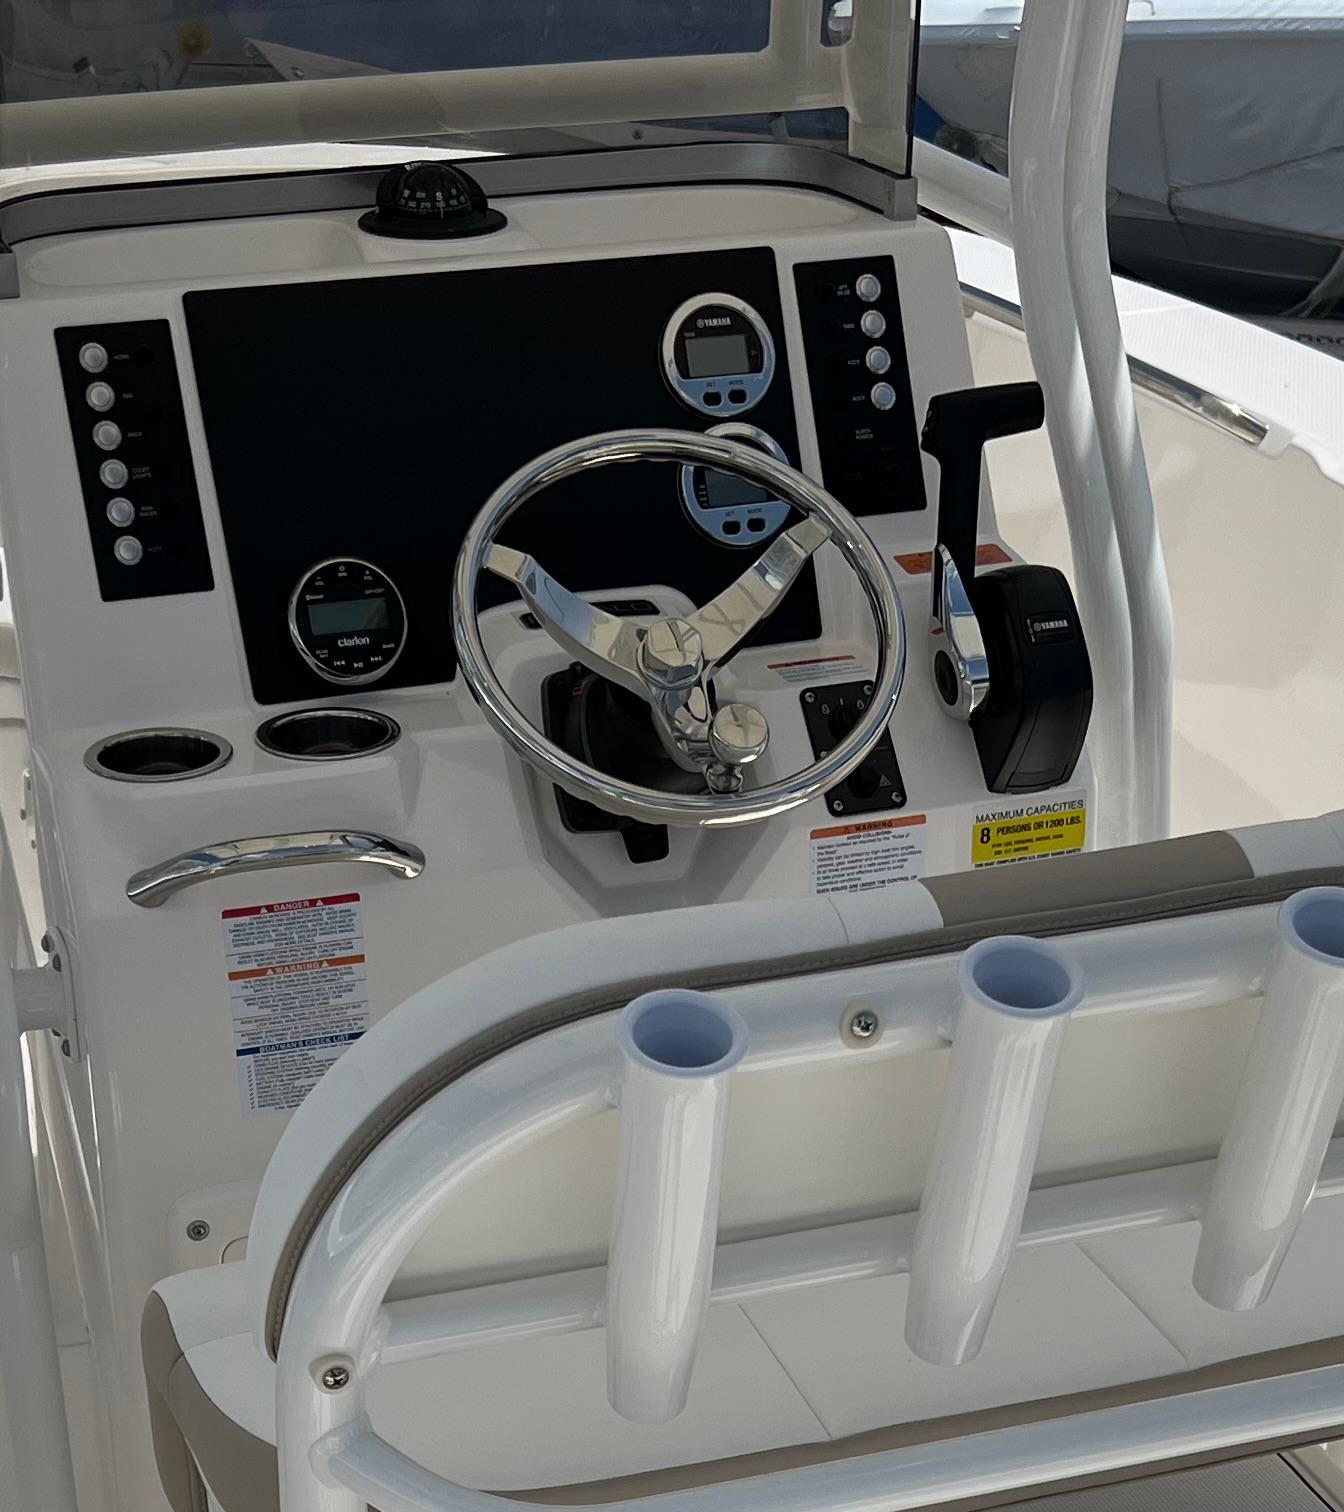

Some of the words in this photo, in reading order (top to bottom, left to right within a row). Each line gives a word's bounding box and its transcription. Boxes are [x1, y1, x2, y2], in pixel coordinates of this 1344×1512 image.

[704, 316, 732, 327] YAMAHA
[337, 636, 370, 647] clarion
[975, 809, 1024, 824] MAXIMUM
[1025, 799, 1084, 817] CAPACITIES
[854, 820, 894, 832] WARNING
[980, 827, 991, 844] 8
[996, 823, 1032, 836] PERSONS
[1033, 821, 1044, 830] OR
[273, 900, 310, 912] DANGER
[274, 962, 320, 974] WARNING
